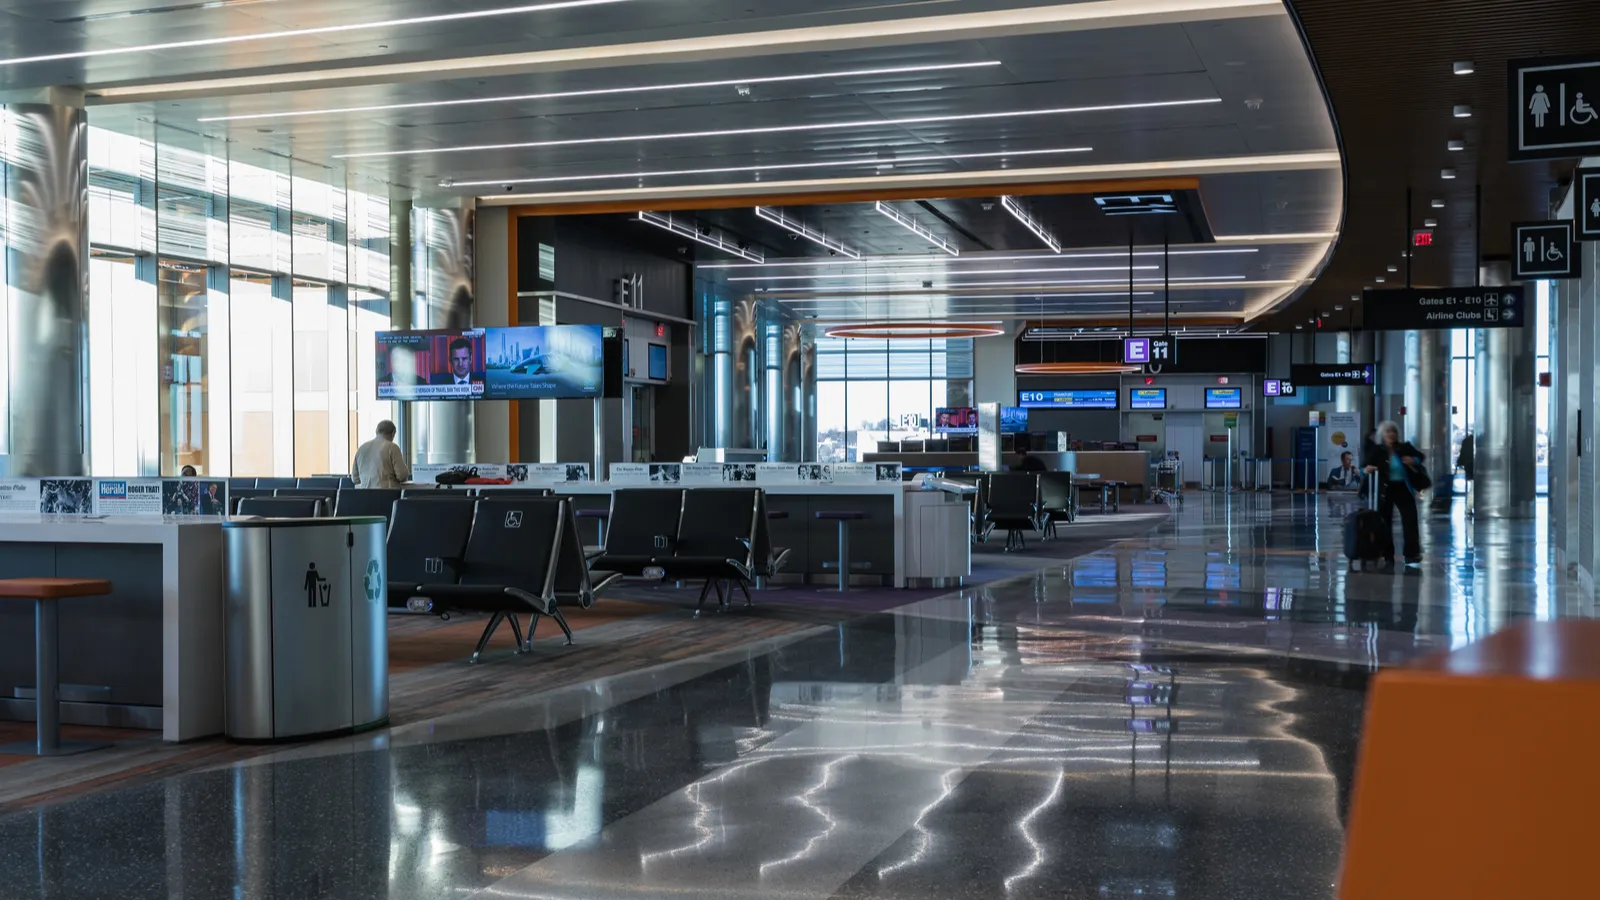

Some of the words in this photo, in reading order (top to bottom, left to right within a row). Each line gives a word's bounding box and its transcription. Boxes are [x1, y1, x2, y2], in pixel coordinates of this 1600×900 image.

[1415, 233, 1432, 245] EXIT
[621, 272, 643, 310] E11
[1419, 297, 1444, 306] Gates
[1446, 297, 1456, 305] E1
[1465, 296, 1481, 304] E10
[1426, 312, 1454, 320] Airline
[1456, 311, 1481, 319] Clubs
[1130, 341, 1144, 359] E
[1152, 347, 1168, 359] 11
[1266, 382, 1277, 393] E
[1281, 386, 1293, 394] 10
[1022, 393, 1044, 401] E10
[101, 483, 124, 494] Herald
